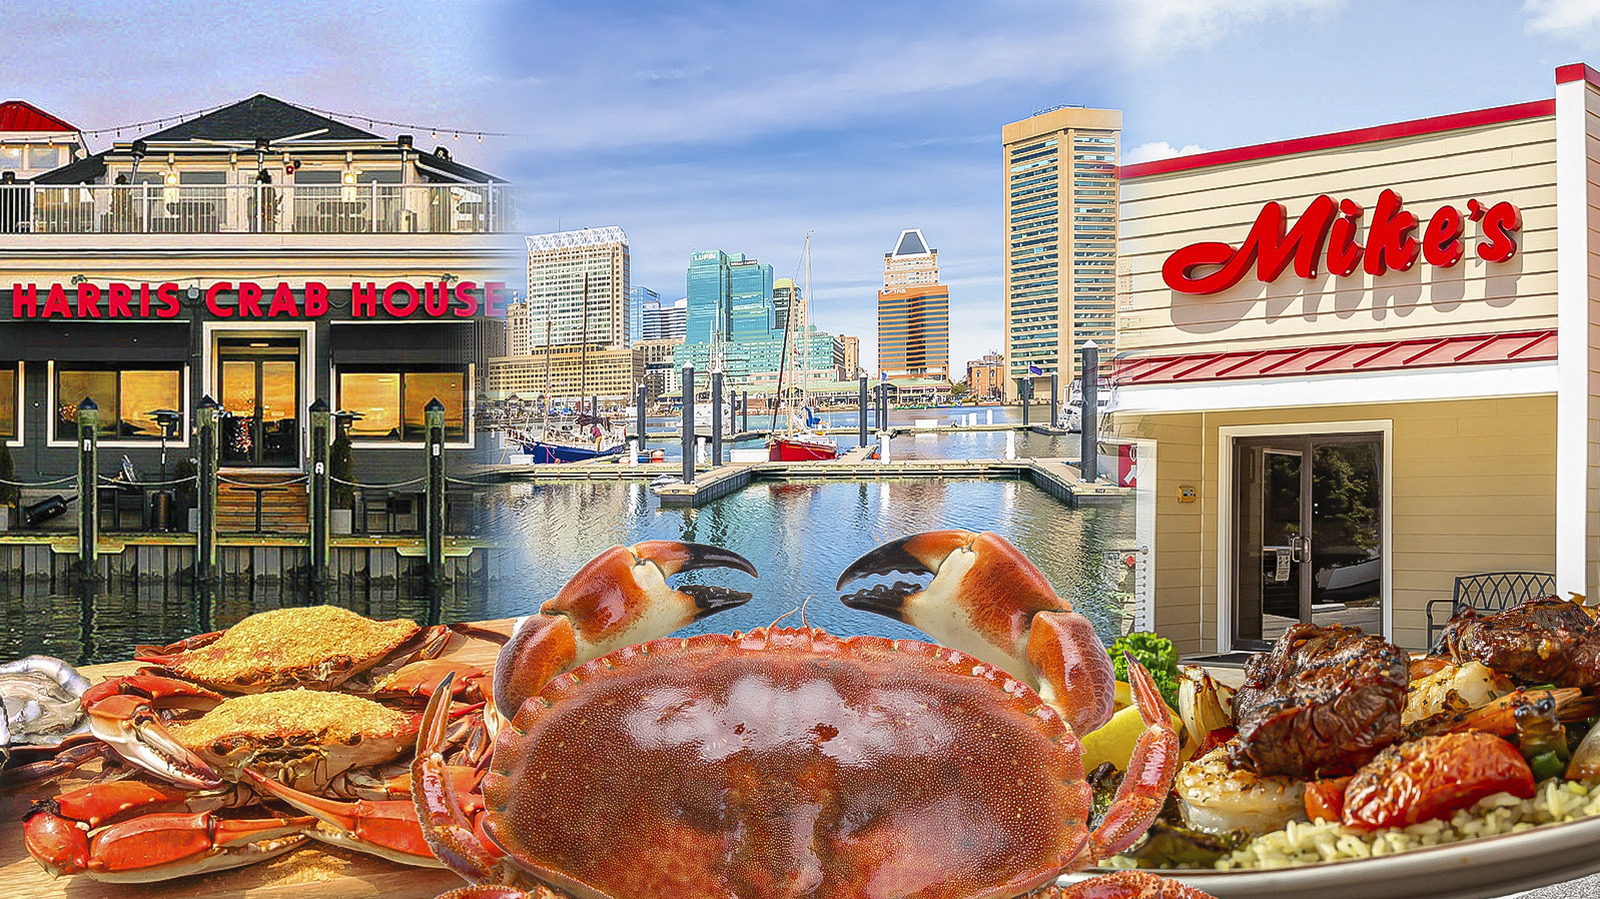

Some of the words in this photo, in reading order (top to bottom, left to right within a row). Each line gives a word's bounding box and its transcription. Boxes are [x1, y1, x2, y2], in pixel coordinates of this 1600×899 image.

[694, 253, 716, 261] LUPIN
[1162, 188, 1522, 294] Mike's
[12, 283, 180, 318] HARRIS
[205, 282, 329, 318] CRAB
[352, 281, 506, 318] HOUSE
